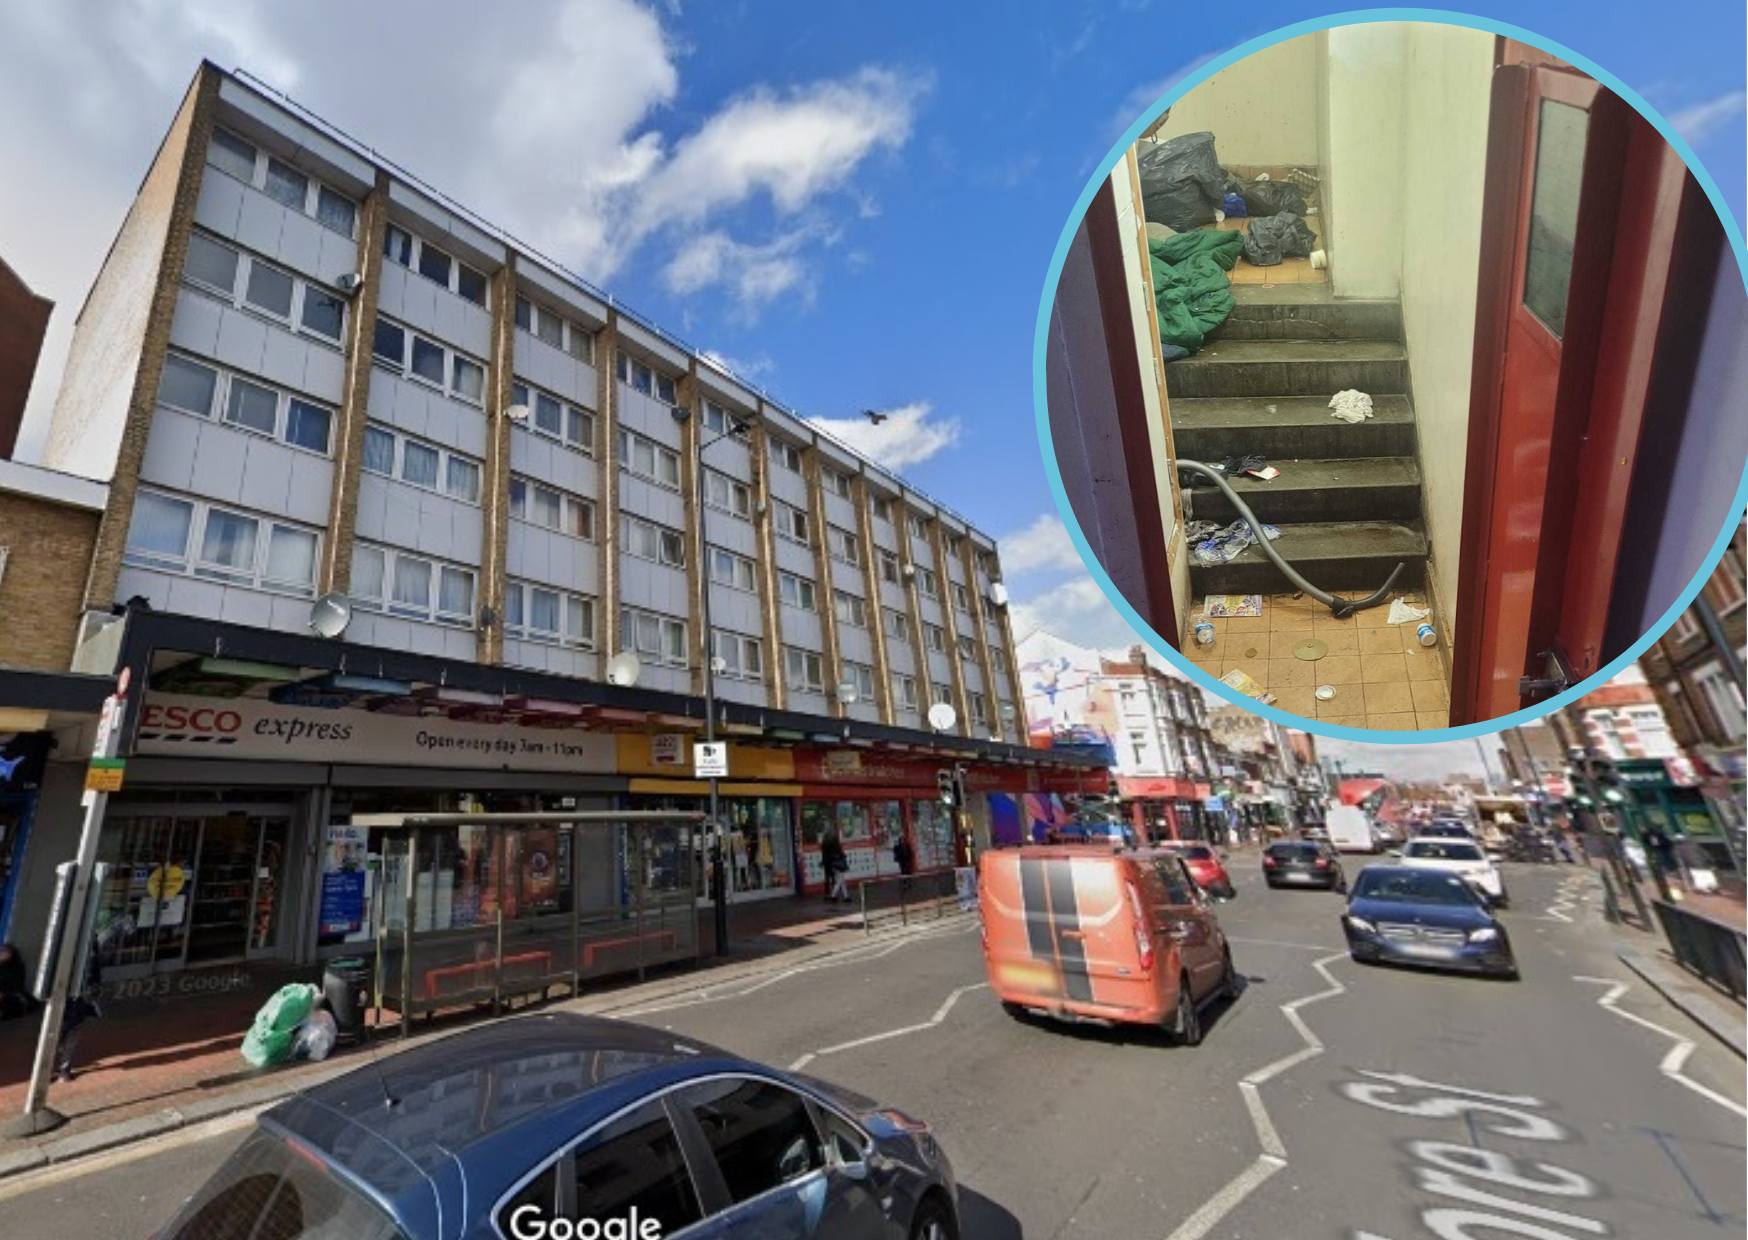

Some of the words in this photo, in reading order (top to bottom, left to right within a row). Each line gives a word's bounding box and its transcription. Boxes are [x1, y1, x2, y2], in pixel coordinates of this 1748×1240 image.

[254, 717, 353, 744] express
[416, 731, 454, 749] Open
[456, 738, 491, 753] every
[494, 738, 516, 754] day
